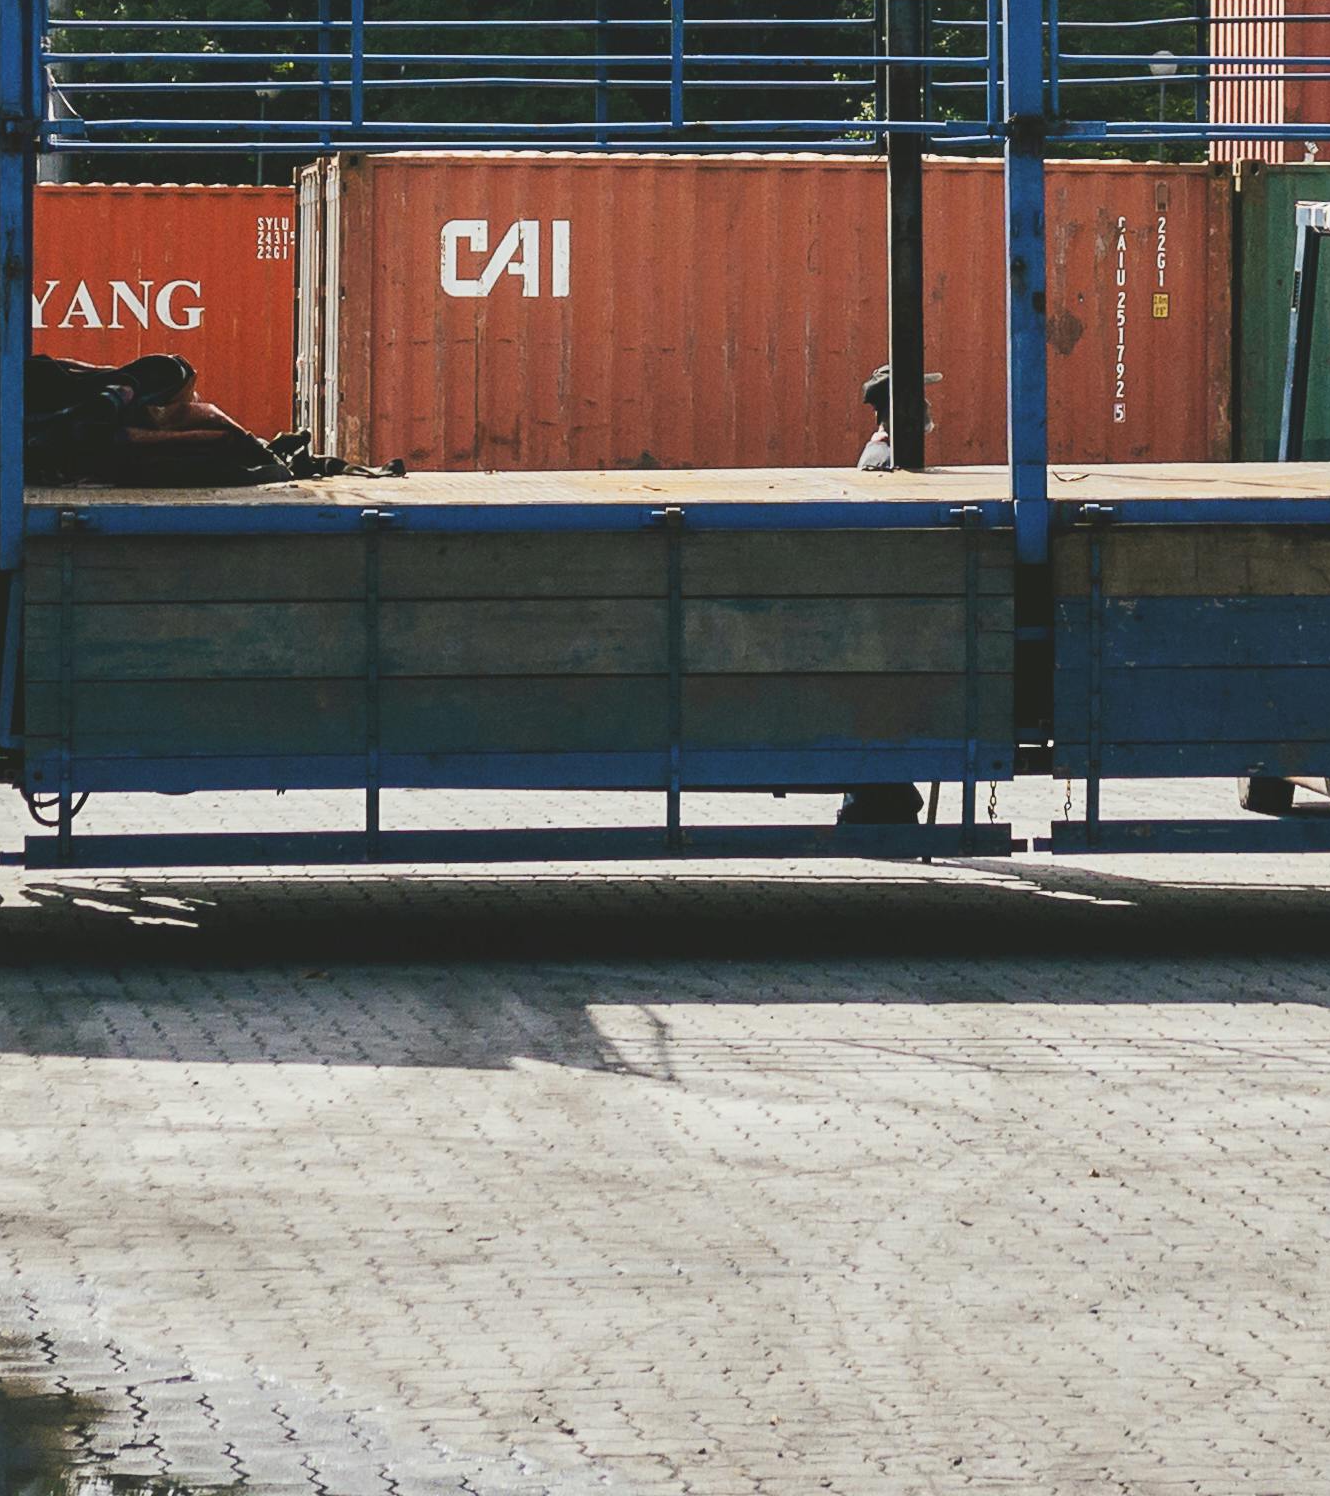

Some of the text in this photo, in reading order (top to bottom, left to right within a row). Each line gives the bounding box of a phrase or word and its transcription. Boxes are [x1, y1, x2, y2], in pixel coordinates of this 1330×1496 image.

[257, 216, 289, 231] SYLU
[257, 245, 288, 260] 22G1
[440, 219, 571, 298] CAI
[1116, 216, 1126, 286] CAIU
[1157, 216, 1166, 287] 22G1
[33, 279, 205, 331] YANG
[1116, 291, 1126, 398] 251792
